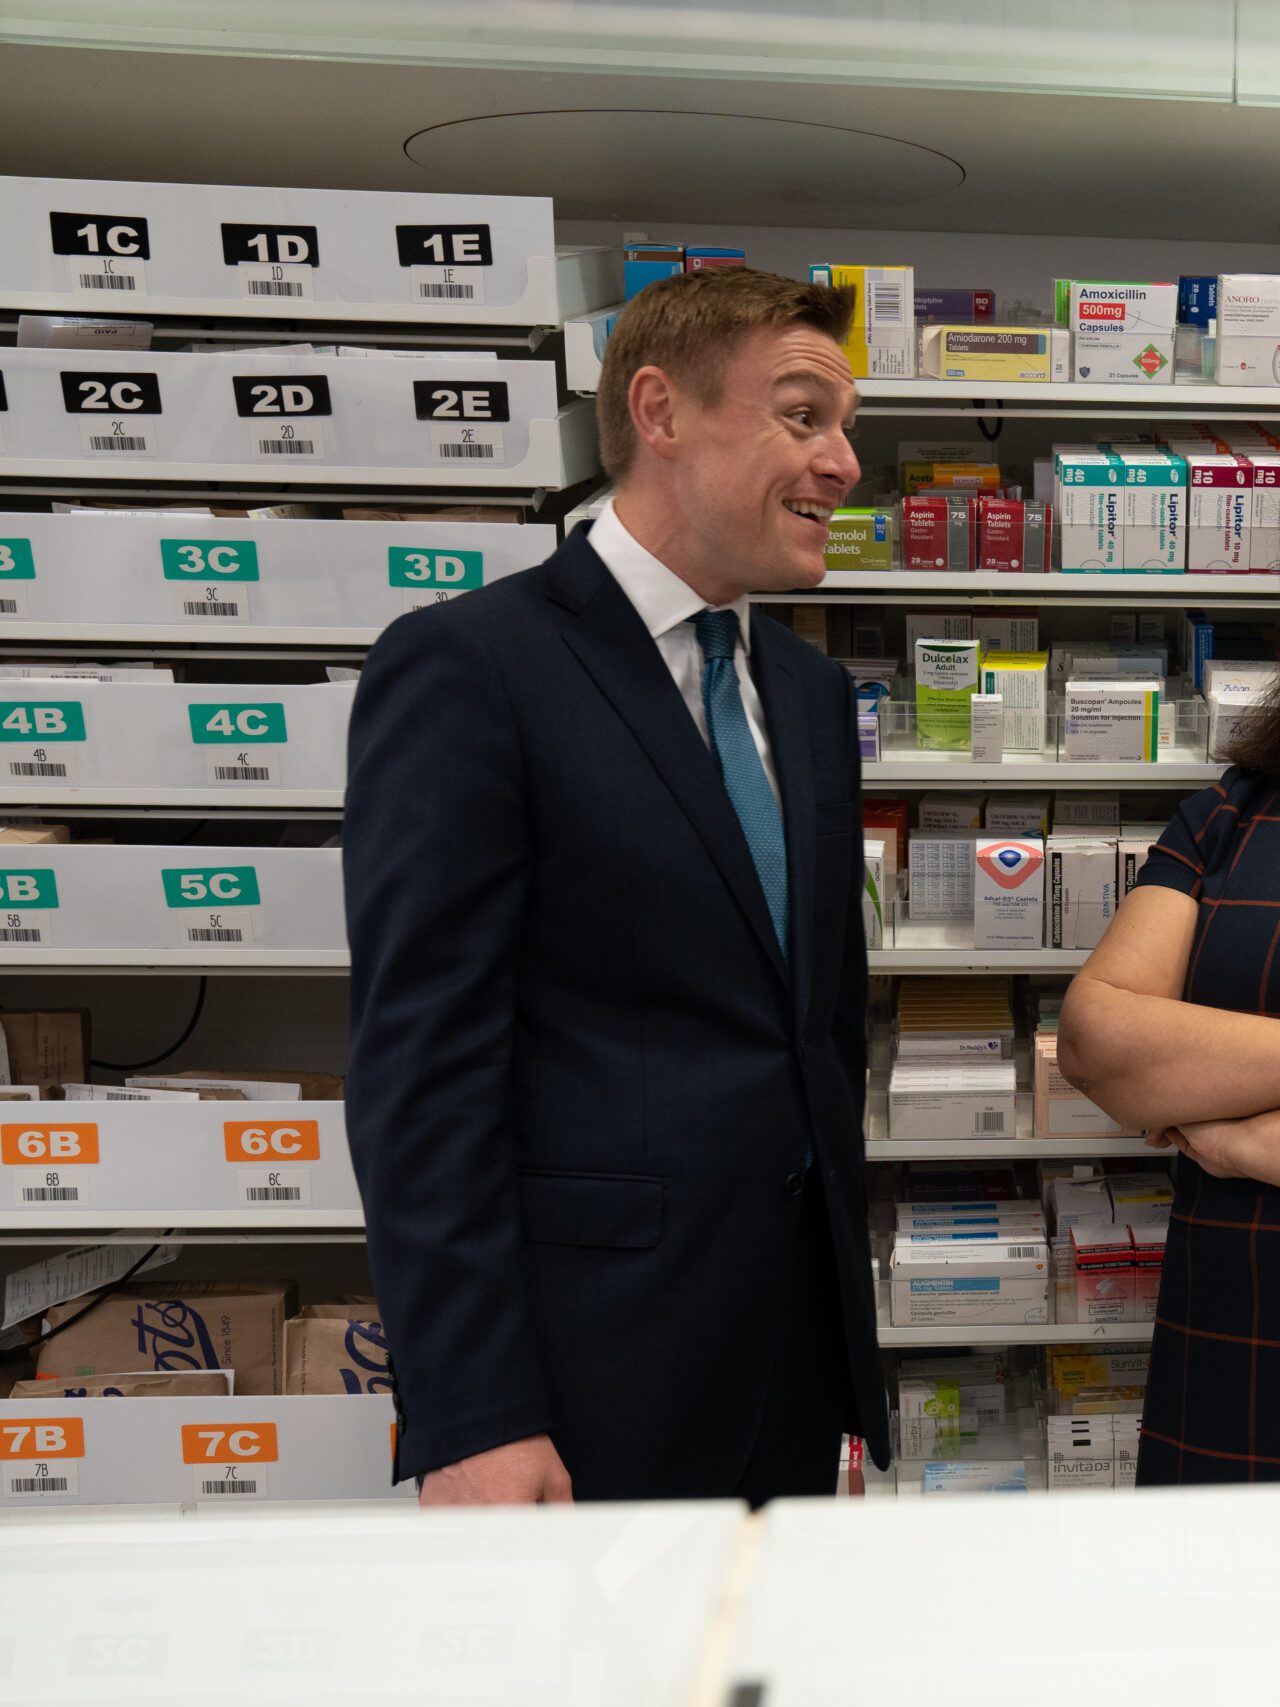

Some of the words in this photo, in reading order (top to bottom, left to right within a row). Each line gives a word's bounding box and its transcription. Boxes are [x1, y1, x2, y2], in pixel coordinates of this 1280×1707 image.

[76, 223, 140, 254] 1C
[247, 233, 309, 263] 1D
[423, 233, 482, 262] 1E
[103, 260, 115, 274] 1C
[271, 266, 283, 280] 1D
[443, 269, 455, 283] 1E
[1080, 289, 1146, 300] Amoxicillin
[1083, 305, 1122, 317] 500mg
[1079, 323, 1124, 333] Capsules
[948, 333, 995, 343] Amiodarone
[998, 335, 1012, 343] 200
[1015, 336, 1027, 345] mg
[79, 381, 144, 409] 2C
[251, 385, 313, 413] 2D
[431, 390, 492, 418] 2E
[112, 422, 125, 436] 2C
[281, 426, 295, 440] 2D
[462, 429, 475, 444] 2E
[1064, 469, 1073, 483] mg
[1075, 469, 1085, 482] 40
[1127, 469, 1135, 483] mg
[1136, 469, 1146, 482] 40
[1193, 470, 1202, 484] mg
[1203, 470, 1213, 484] 10
[1255, 470, 1264, 484] mg
[1265, 470, 1275, 484] 10
[910, 511, 934, 521] Aspirin
[987, 512, 1011, 521] Aspirin
[1108, 493, 1117, 536] Lipitor
[1169, 493, 1178, 536] Lipitor
[1234, 494, 1244, 540] Lipitor
[910, 519, 934, 527] Tablets
[987, 520, 1011, 528] Tablets
[1108, 540, 1114, 550] 40
[1169, 540, 1176, 550] 40
[1234, 541, 1241, 551] 10
[0, 545, 15, 572] B
[178, 546, 240, 574] 3C
[1106, 552, 1113, 562] mg
[1167, 552, 1175, 563] mg
[1232, 552, 1239, 563] mg
[404, 554, 466, 582] 3D
[206, 587, 219, 601] 3C
[436, 592, 448, 603] 3D
[922, 653, 968, 663] Dulcolax
[2, 708, 67, 735] 4B
[206, 709, 270, 736] 4C
[33, 748, 47, 762] 4B
[237, 752, 249, 766] 4C
[1053, 858, 1061, 884] Capsules
[1126, 860, 1134, 886] Capsules
[0, 875, 40, 901] B
[180, 873, 242, 900] 5C
[1053, 885, 1061, 905] 375mg
[7, 914, 21, 928] 5B
[210, 914, 223, 928] 5C
[1053, 906, 1061, 943] Carbocisteine
[17, 1131, 81, 1157] 6B
[240, 1128, 303, 1154] 6C
[46, 1173, 60, 1187] 6B
[268, 1173, 281, 1187] 6C
[222, 1339, 231, 1364] Since
[2, 1425, 67, 1452] 7B
[198, 1430, 262, 1457] 7C
[35, 1463, 49, 1478] 7B
[225, 1466, 238, 1480] 7C
[1054, 1461, 1110, 1473] invitaD3
